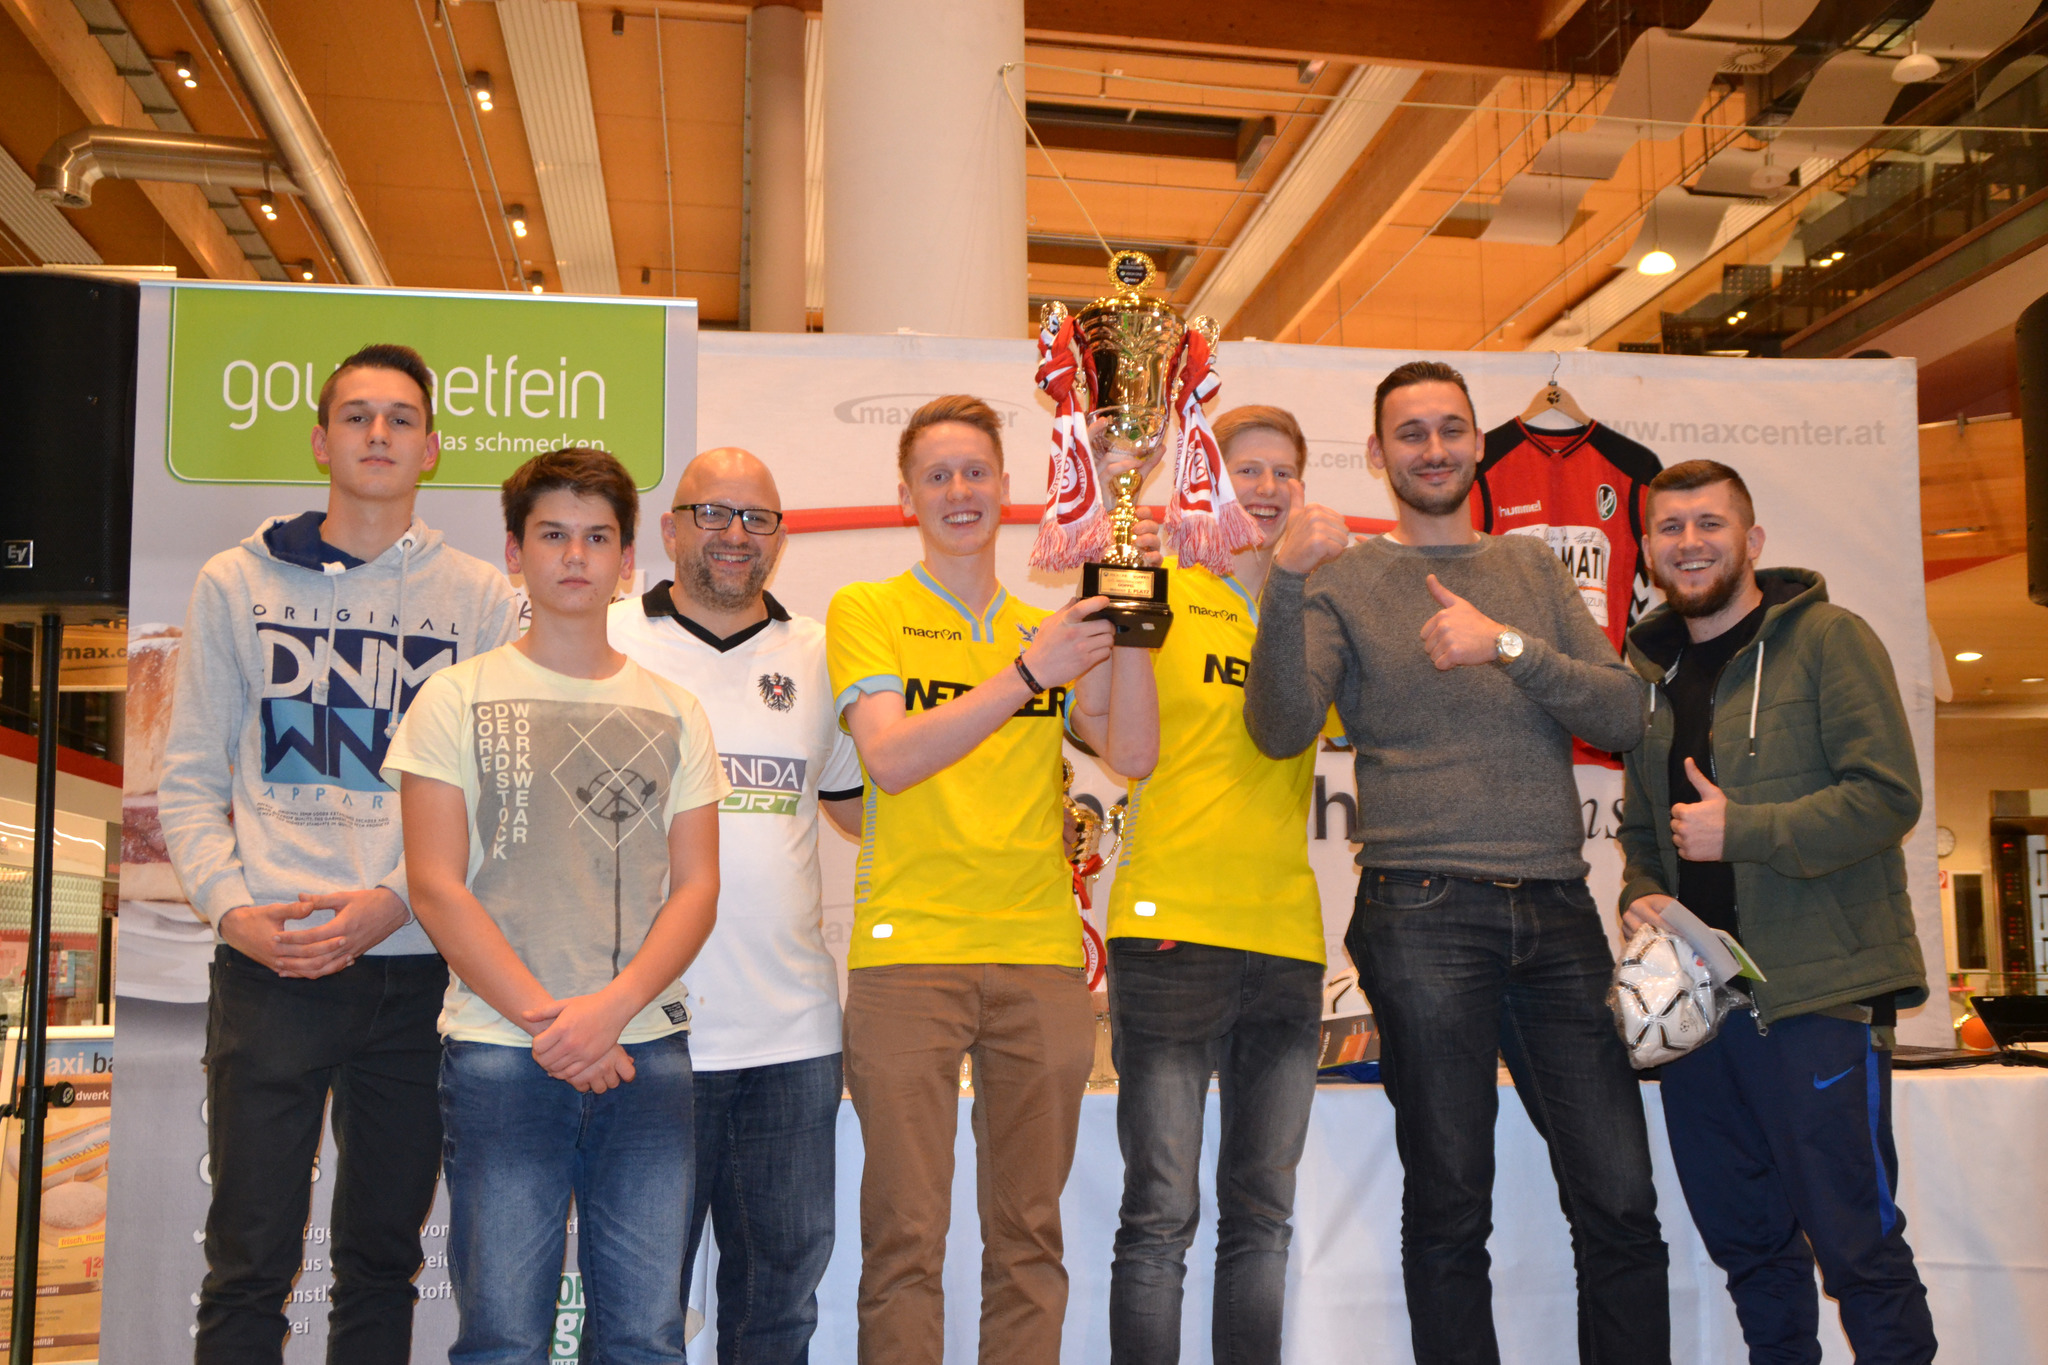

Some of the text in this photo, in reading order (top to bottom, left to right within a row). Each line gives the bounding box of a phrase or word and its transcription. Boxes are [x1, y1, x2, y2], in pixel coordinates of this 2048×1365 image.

[222, 353, 606, 431] gouetfein
[438, 431, 467, 452] as
[1603, 419, 1886, 446] ww.maxcenter.at
[1498, 499, 1543, 518] hummel
[1188, 604, 1239, 623] macron
[902, 625, 963, 641] macron
[511, 702, 534, 844] WORKWEAR
